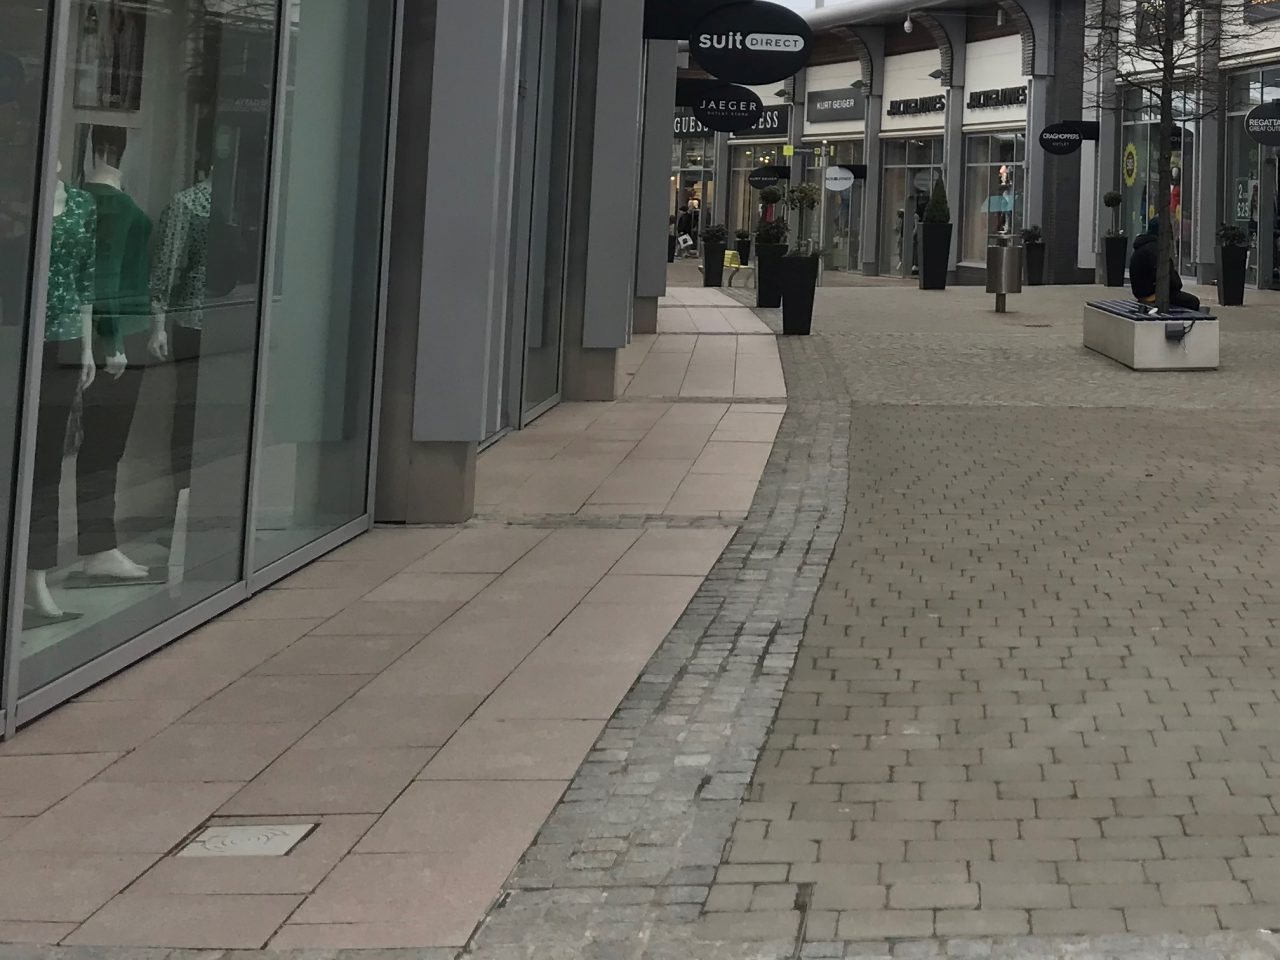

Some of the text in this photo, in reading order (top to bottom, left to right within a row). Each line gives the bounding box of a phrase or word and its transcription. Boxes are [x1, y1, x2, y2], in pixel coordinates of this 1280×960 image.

[699, 32, 800, 49] suit DIRECT
[700, 100, 757, 111] JAEGER
[816, 98, 855, 110] KURT GEIGER
[1249, 118, 1280, 126] REGATTA
[1042, 132, 1080, 140] CRAGHOPPERS
